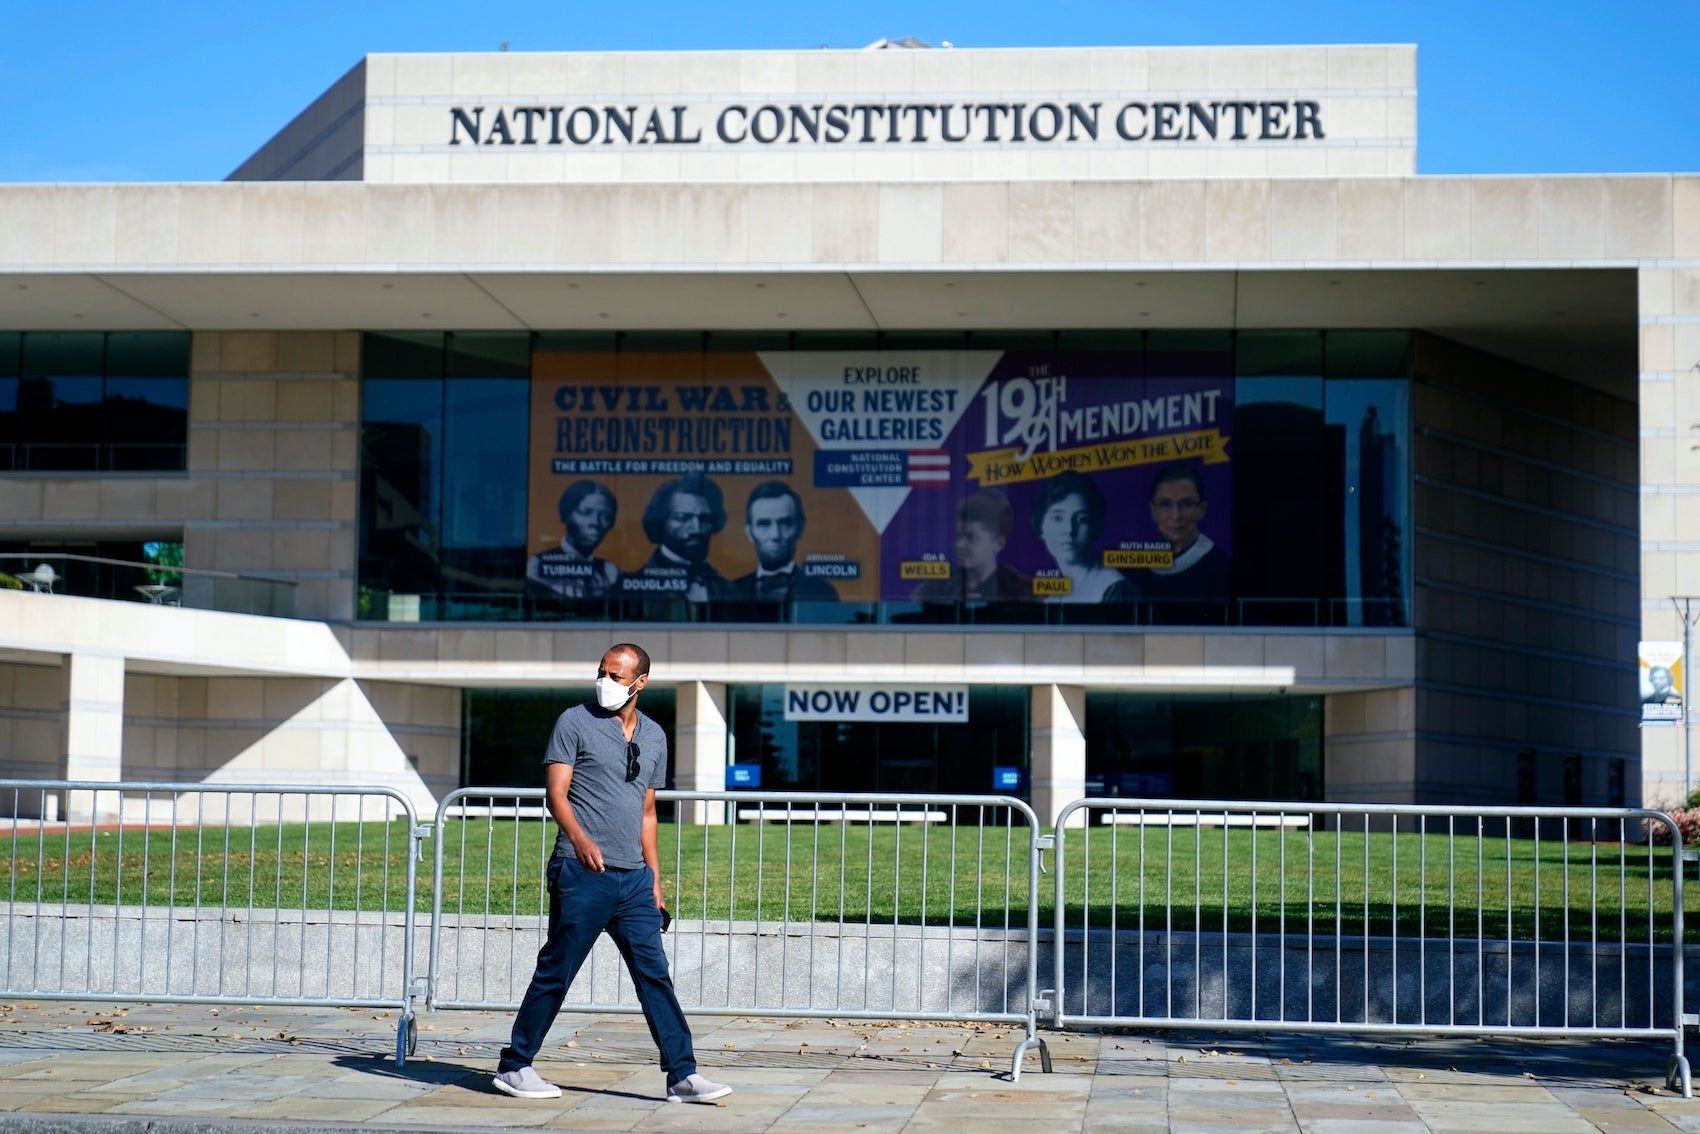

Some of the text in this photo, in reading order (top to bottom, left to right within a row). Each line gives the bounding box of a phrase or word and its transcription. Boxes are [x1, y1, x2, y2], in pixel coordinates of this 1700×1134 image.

[449, 101, 1325, 145] NATIONAL CONSTITUTION CENTER
[843, 366, 921, 384] EXPLORE
[554, 385, 793, 412] CIVIL WAR &
[807, 388, 958, 413] OUR NEWEST
[981, 375, 1067, 448] 19TH
[820, 417, 944, 441] GALLERIES
[1014, 389, 1222, 462] AMENDMENT
[555, 416, 793, 454] RECONSTRUCTION
[851, 453, 902, 462] NATIONAL
[984, 434, 1214, 482] HOW WOMEN WON THE VOTE
[554, 460, 791, 472] THE BATTLE FOR FREEDOM AND EQUALITY
[827, 463, 902, 473] CONSTITUTION
[861, 474, 902, 483] CENTER
[1120, 542, 1171, 550] RUTH BADER
[1107, 553, 1171, 564] GINSBURG
[542, 565, 593, 576] TUBMAN
[805, 564, 858, 577] LINCOLN
[904, 564, 947, 576] WELLS
[1037, 569, 1060, 577] ALICE
[622, 579, 688, 590] DOUGLASS
[1037, 581, 1068, 591] PAUL
[788, 689, 964, 715] NOW OPEN!
